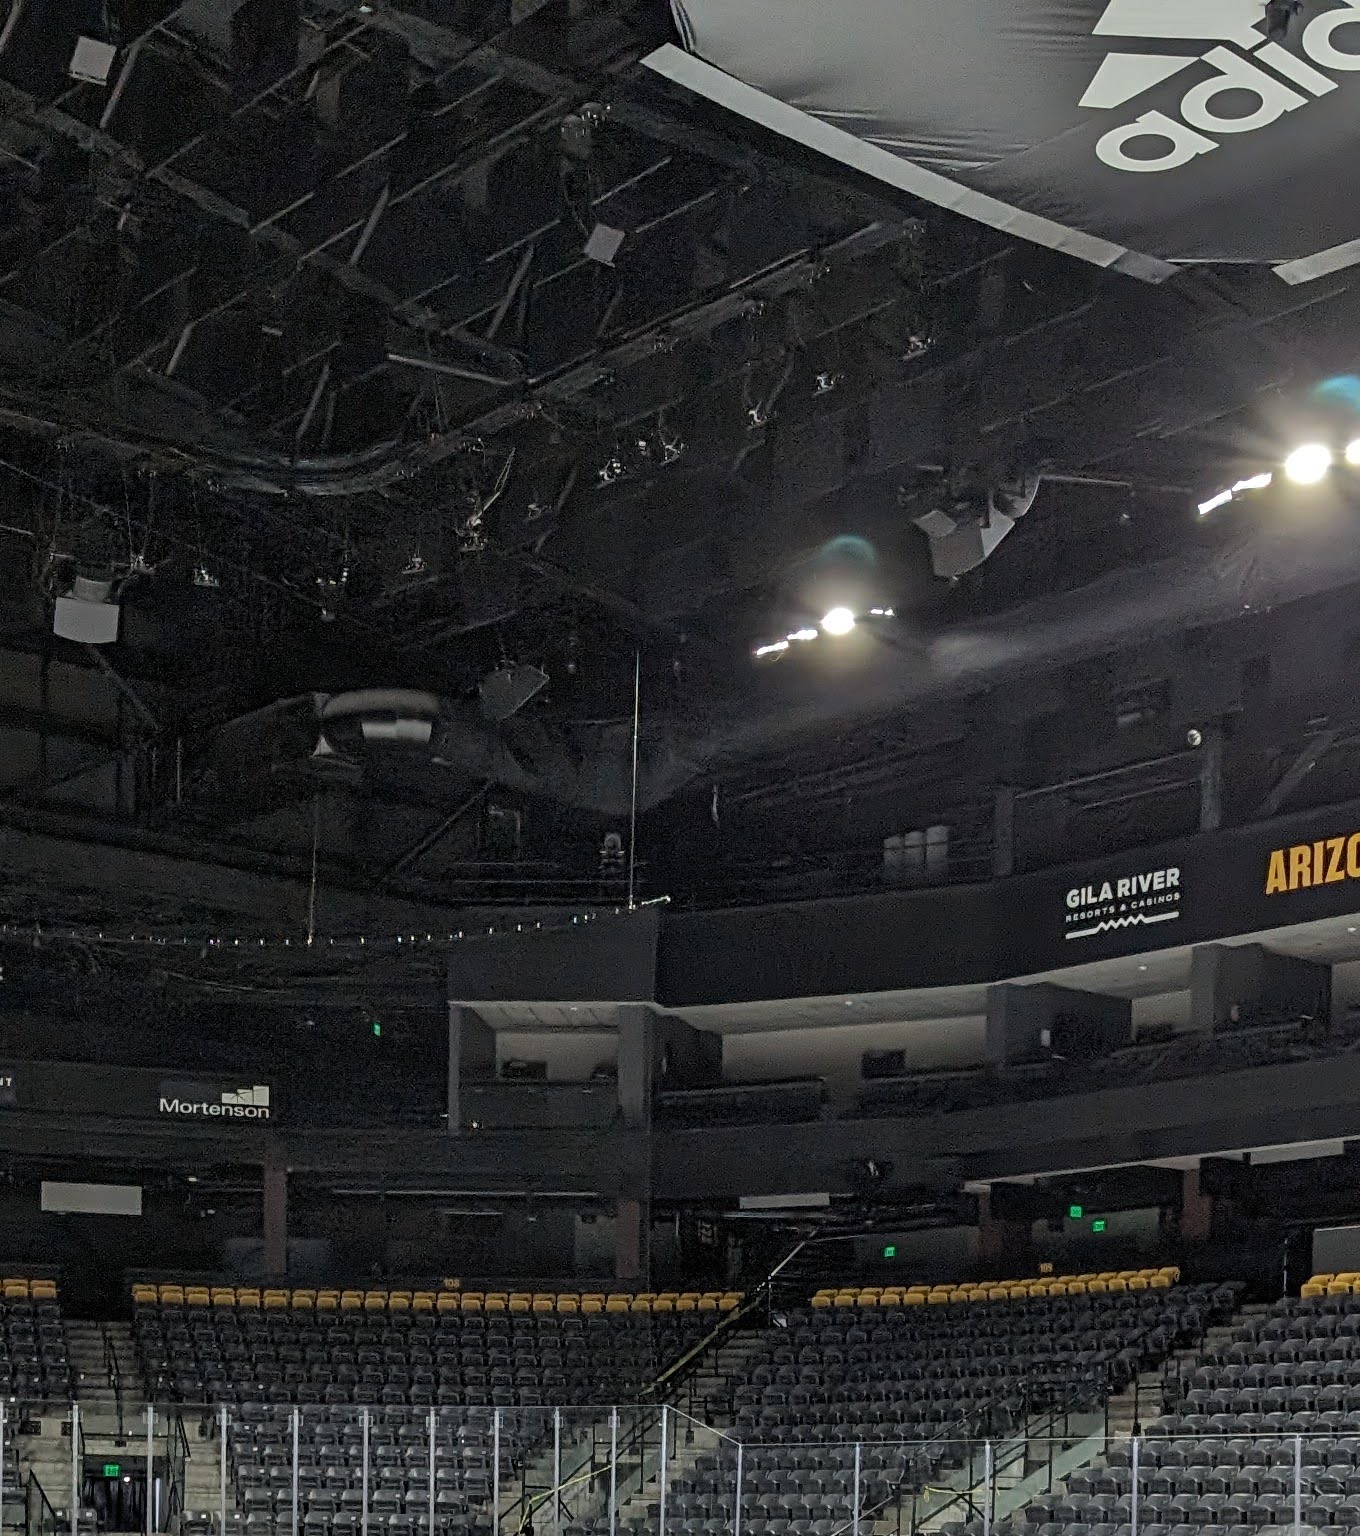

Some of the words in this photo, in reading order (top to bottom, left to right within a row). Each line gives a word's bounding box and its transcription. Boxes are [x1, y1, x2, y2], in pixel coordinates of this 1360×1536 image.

[1066, 881, 1113, 909] GILA
[1117, 867, 1180, 898] RIVER
[1065, 905, 1115, 923] RESORTS
[1130, 892, 1180, 909] CASINOS
[159, 1098, 270, 1119] Mortenson
